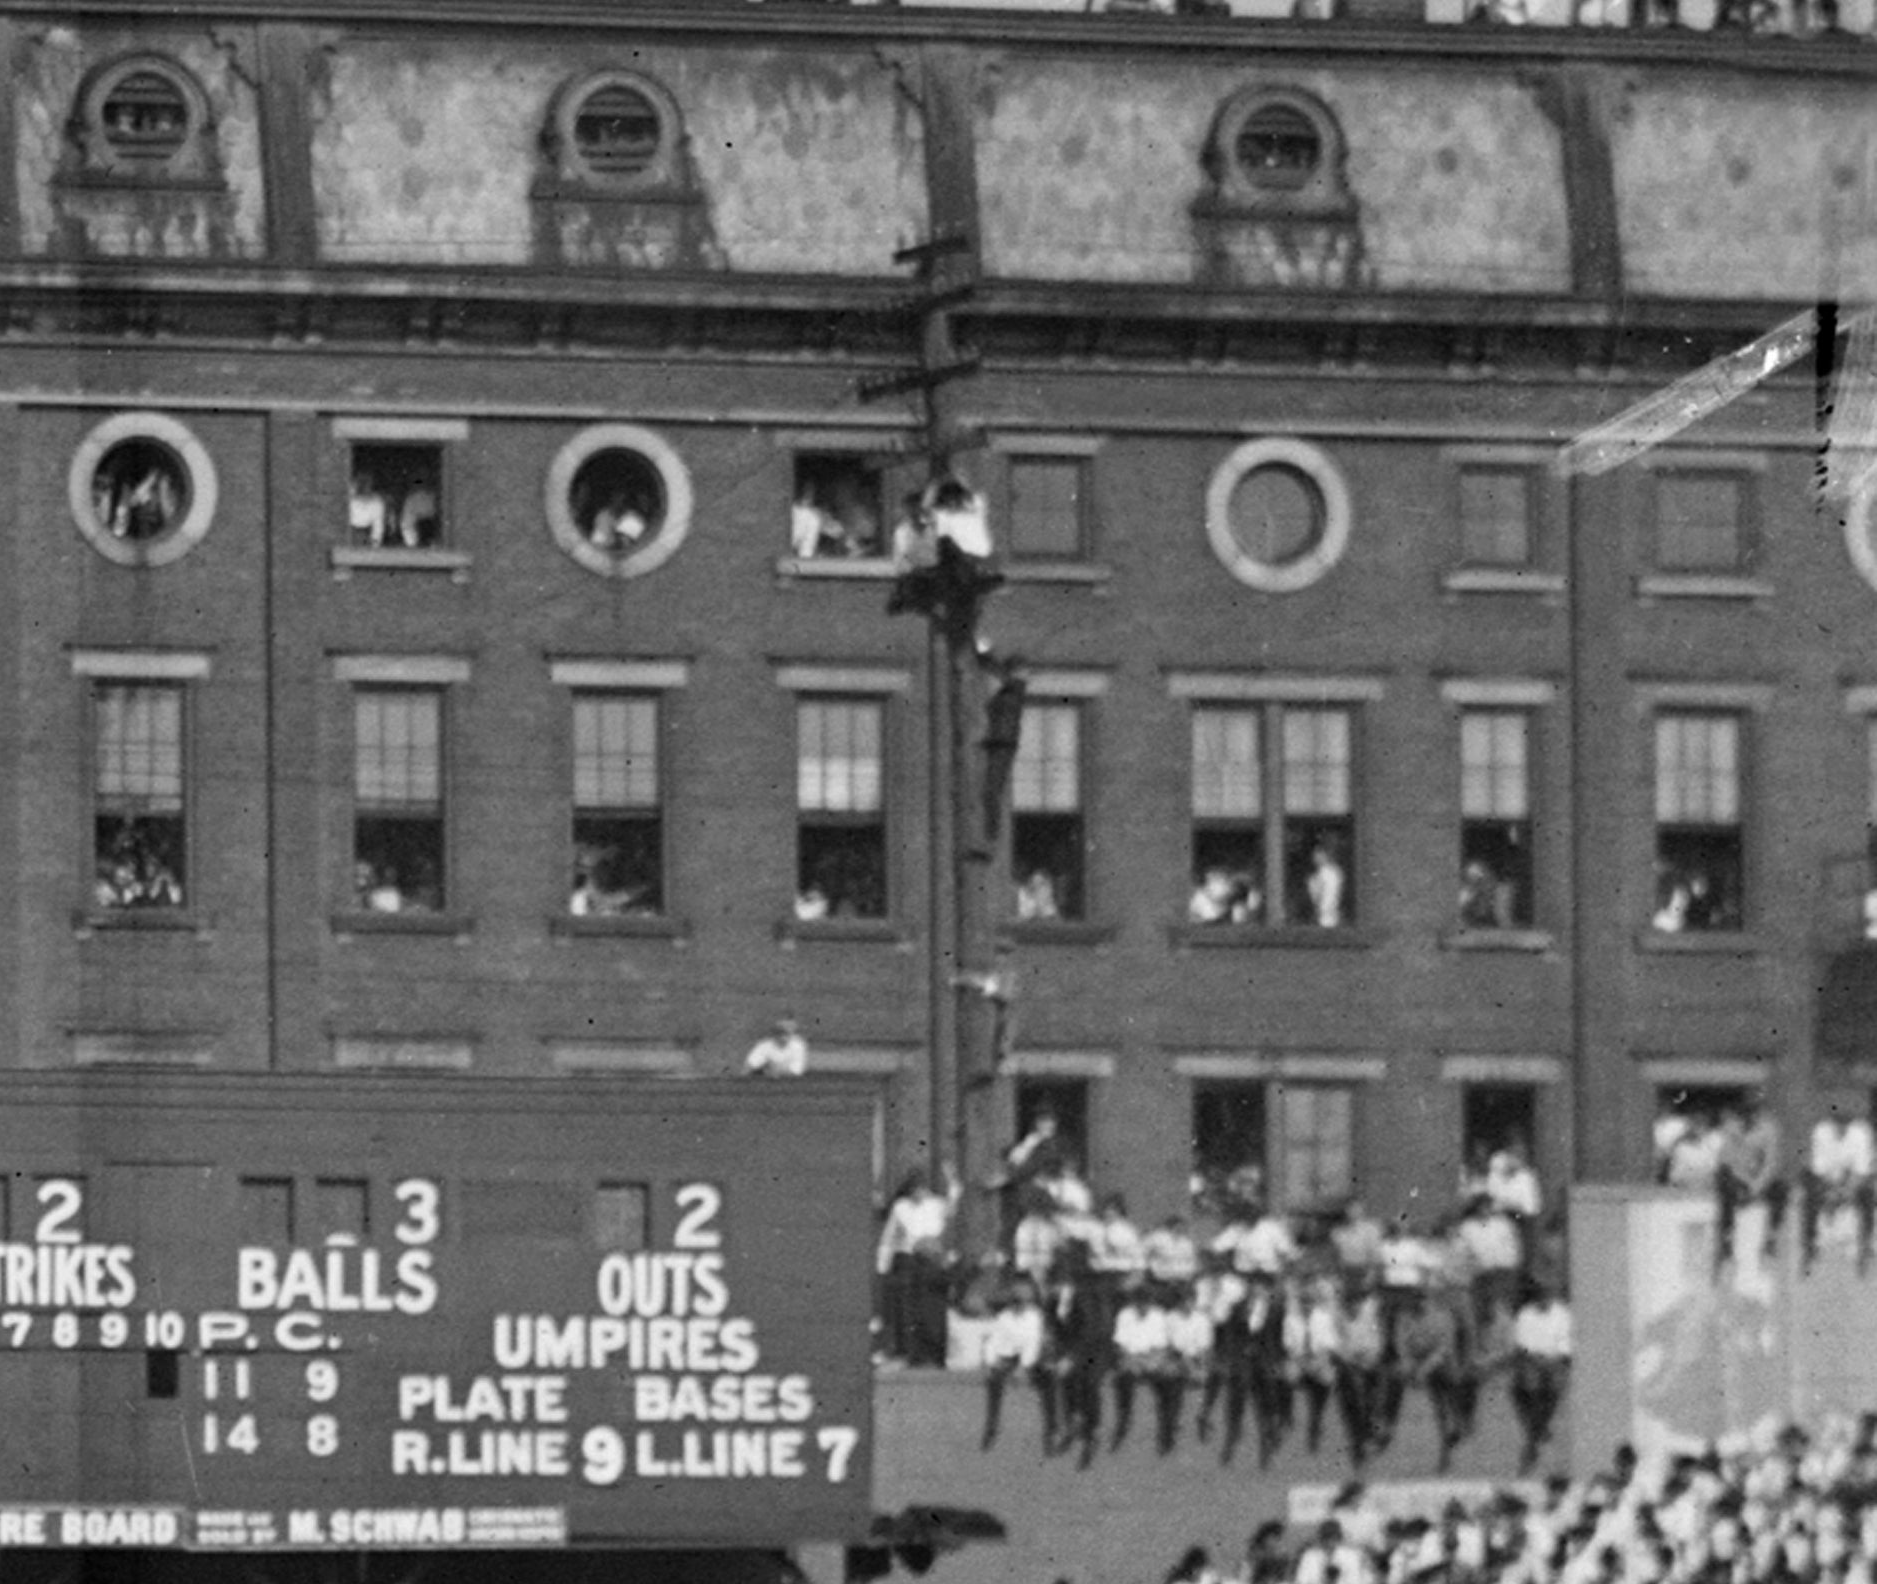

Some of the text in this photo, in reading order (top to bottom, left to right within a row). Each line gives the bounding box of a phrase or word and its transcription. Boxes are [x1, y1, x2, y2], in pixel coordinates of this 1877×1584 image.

[35, 1180, 83, 1245] 2
[395, 1179, 441, 1247] 3
[674, 1184, 722, 1250] 2
[238, 1247, 439, 1315] BALLS
[598, 1253, 730, 1317] OUTS
[1, 1312, 35, 1349] 7
[52, 1312, 81, 1350] 8
[99, 1313, 130, 1350] 9
[145, 1311, 187, 1350] 10
[198, 1311, 260, 1351] P.
[274, 1311, 344, 1353] C.
[494, 1313, 760, 1374] UMPIRES
[305, 1360, 340, 1404] 9
[399, 1375, 815, 1424] PLATE BASES
[203, 1414, 261, 1456] 14
[307, 1415, 340, 1458] 8
[582, 1426, 626, 1486] 9
[817, 1426, 860, 1484] 7
[60, 1510, 178, 1546] BOARD
